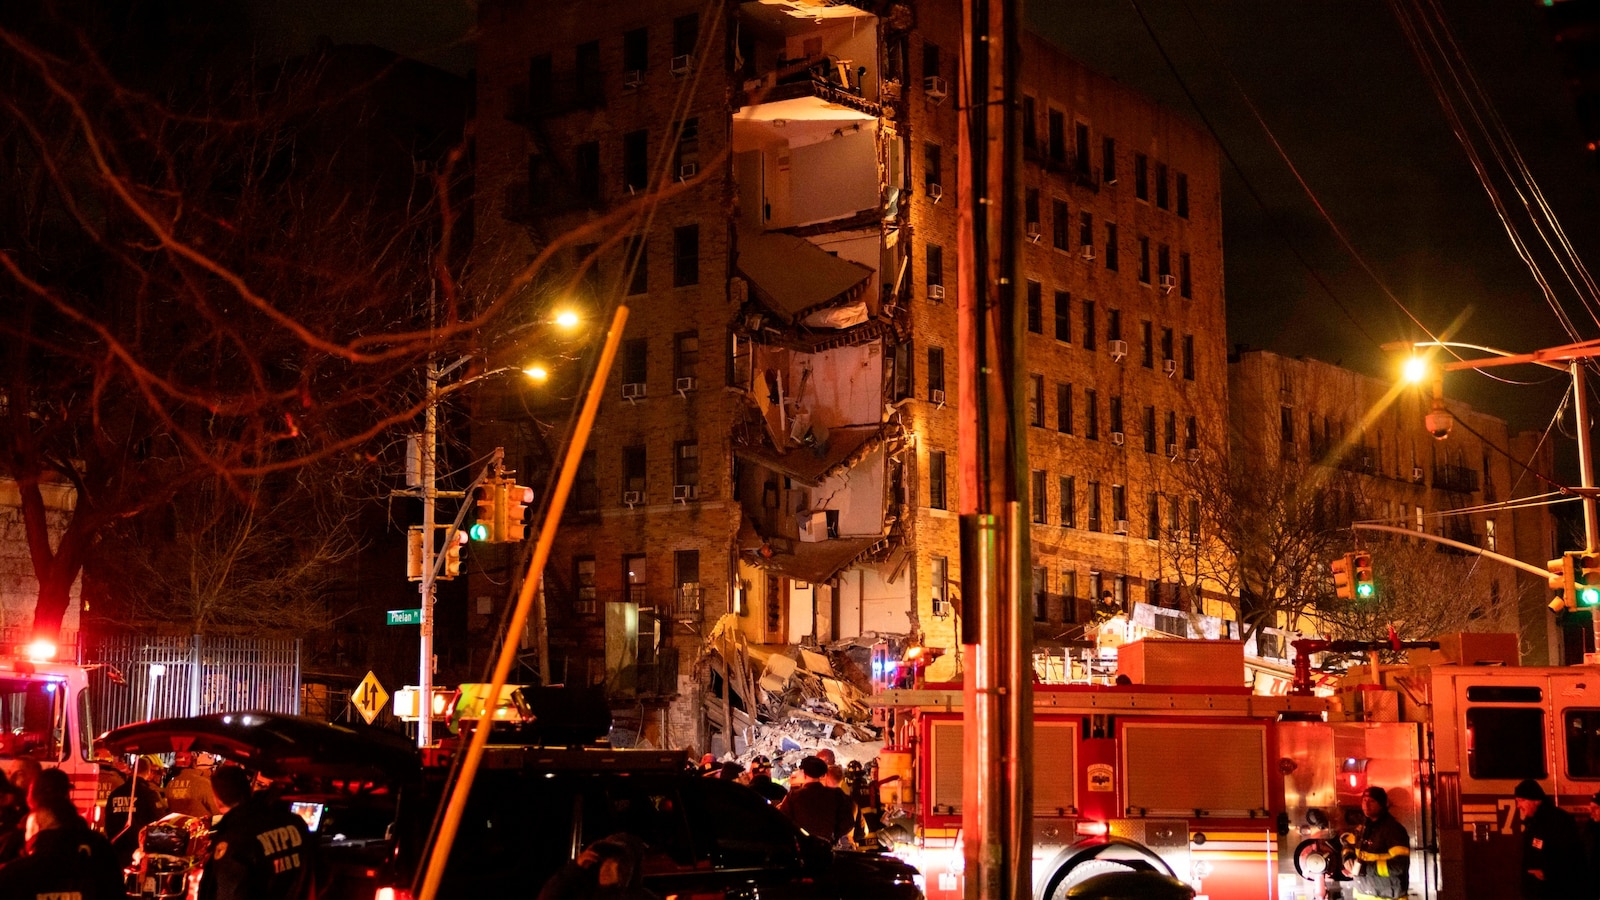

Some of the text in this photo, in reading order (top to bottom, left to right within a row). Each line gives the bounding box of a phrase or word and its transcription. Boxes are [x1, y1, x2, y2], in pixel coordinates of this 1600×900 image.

[391, 612, 412, 622] Phelan
[98, 782, 112, 791] DNY
[113, 796, 138, 807] FDNY
[256, 824, 302, 856] NYPD
